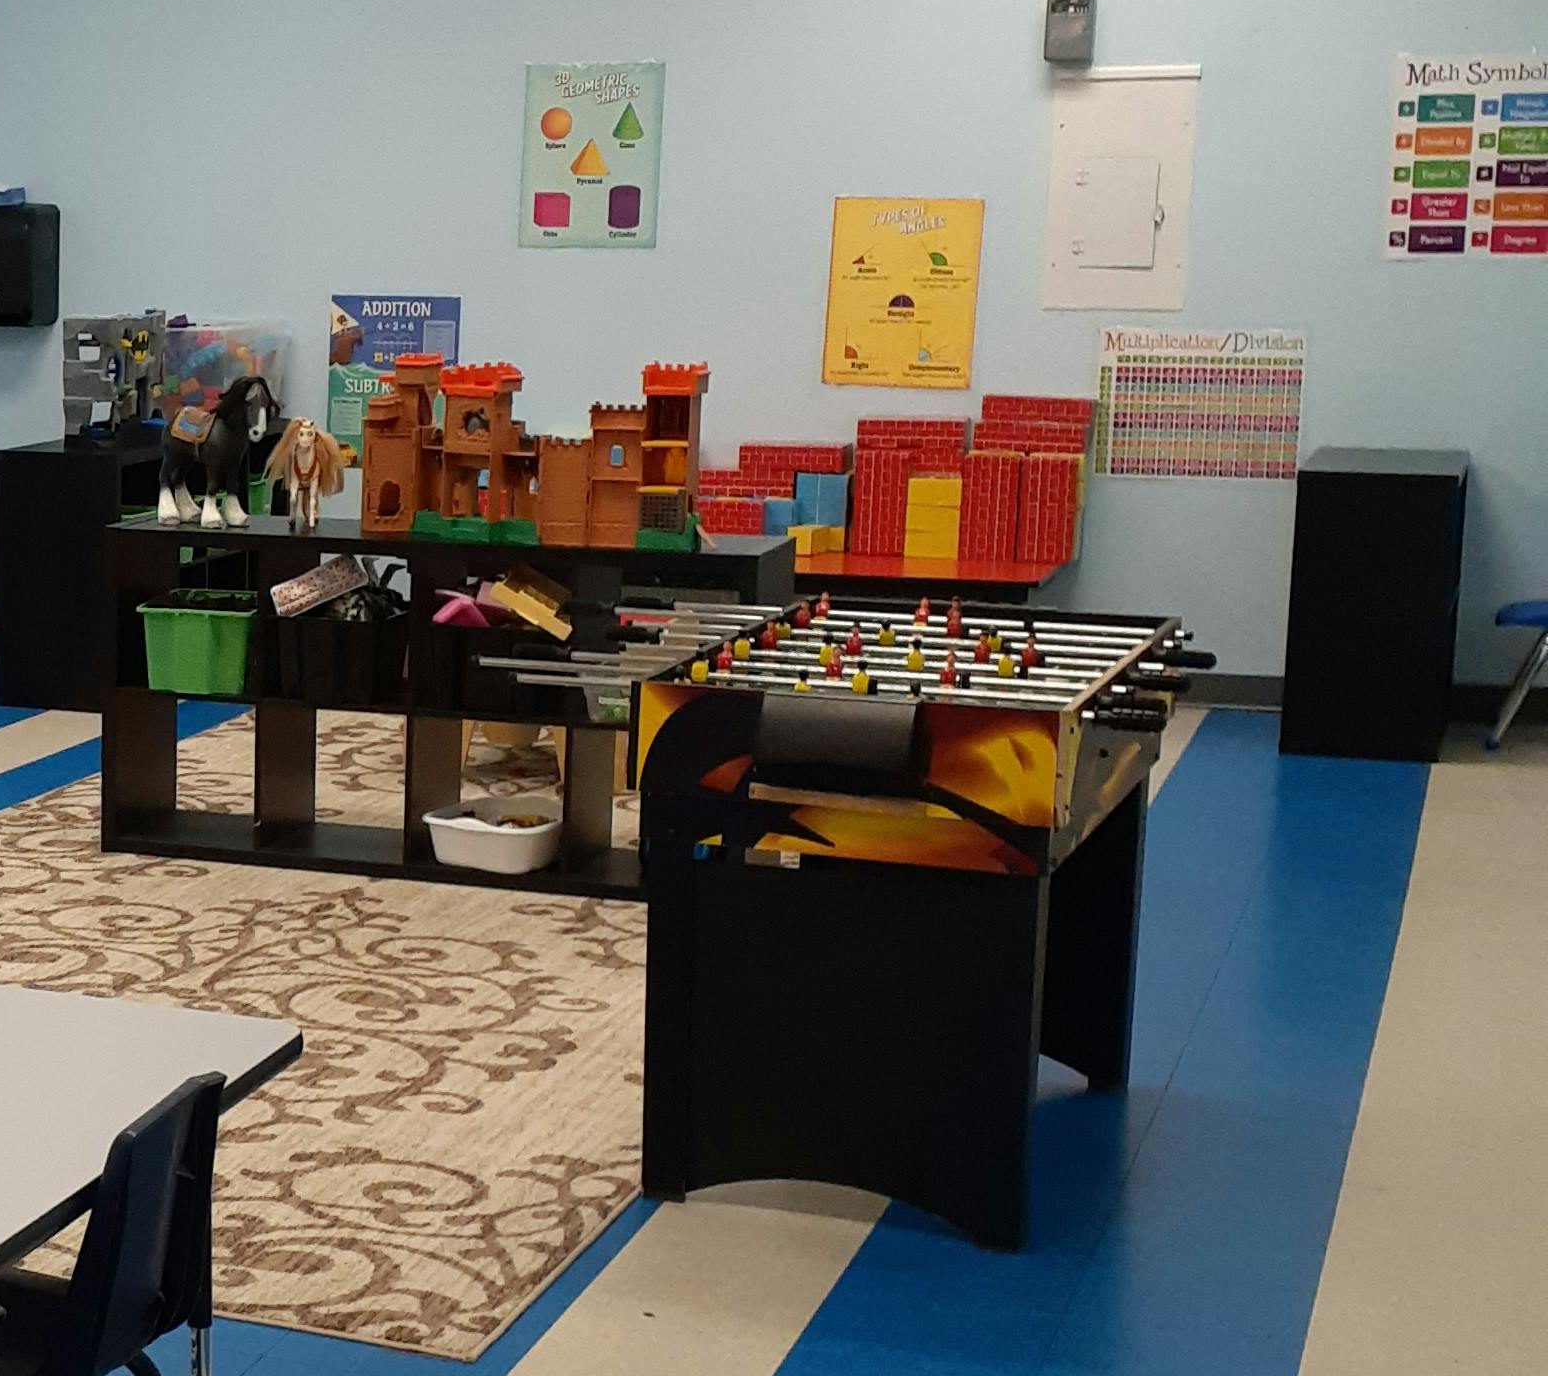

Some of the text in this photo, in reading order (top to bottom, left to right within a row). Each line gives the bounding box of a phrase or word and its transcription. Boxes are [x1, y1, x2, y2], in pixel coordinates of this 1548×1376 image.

[555, 72, 570, 86] 3D
[1405, 62, 1460, 87] Math
[560, 72, 628, 98] GEOMETRIC
[595, 85, 641, 105] SHAPES
[362, 300, 432, 317] ADDITION
[376, 321, 384, 331] 4
[392, 321, 400, 331] 2
